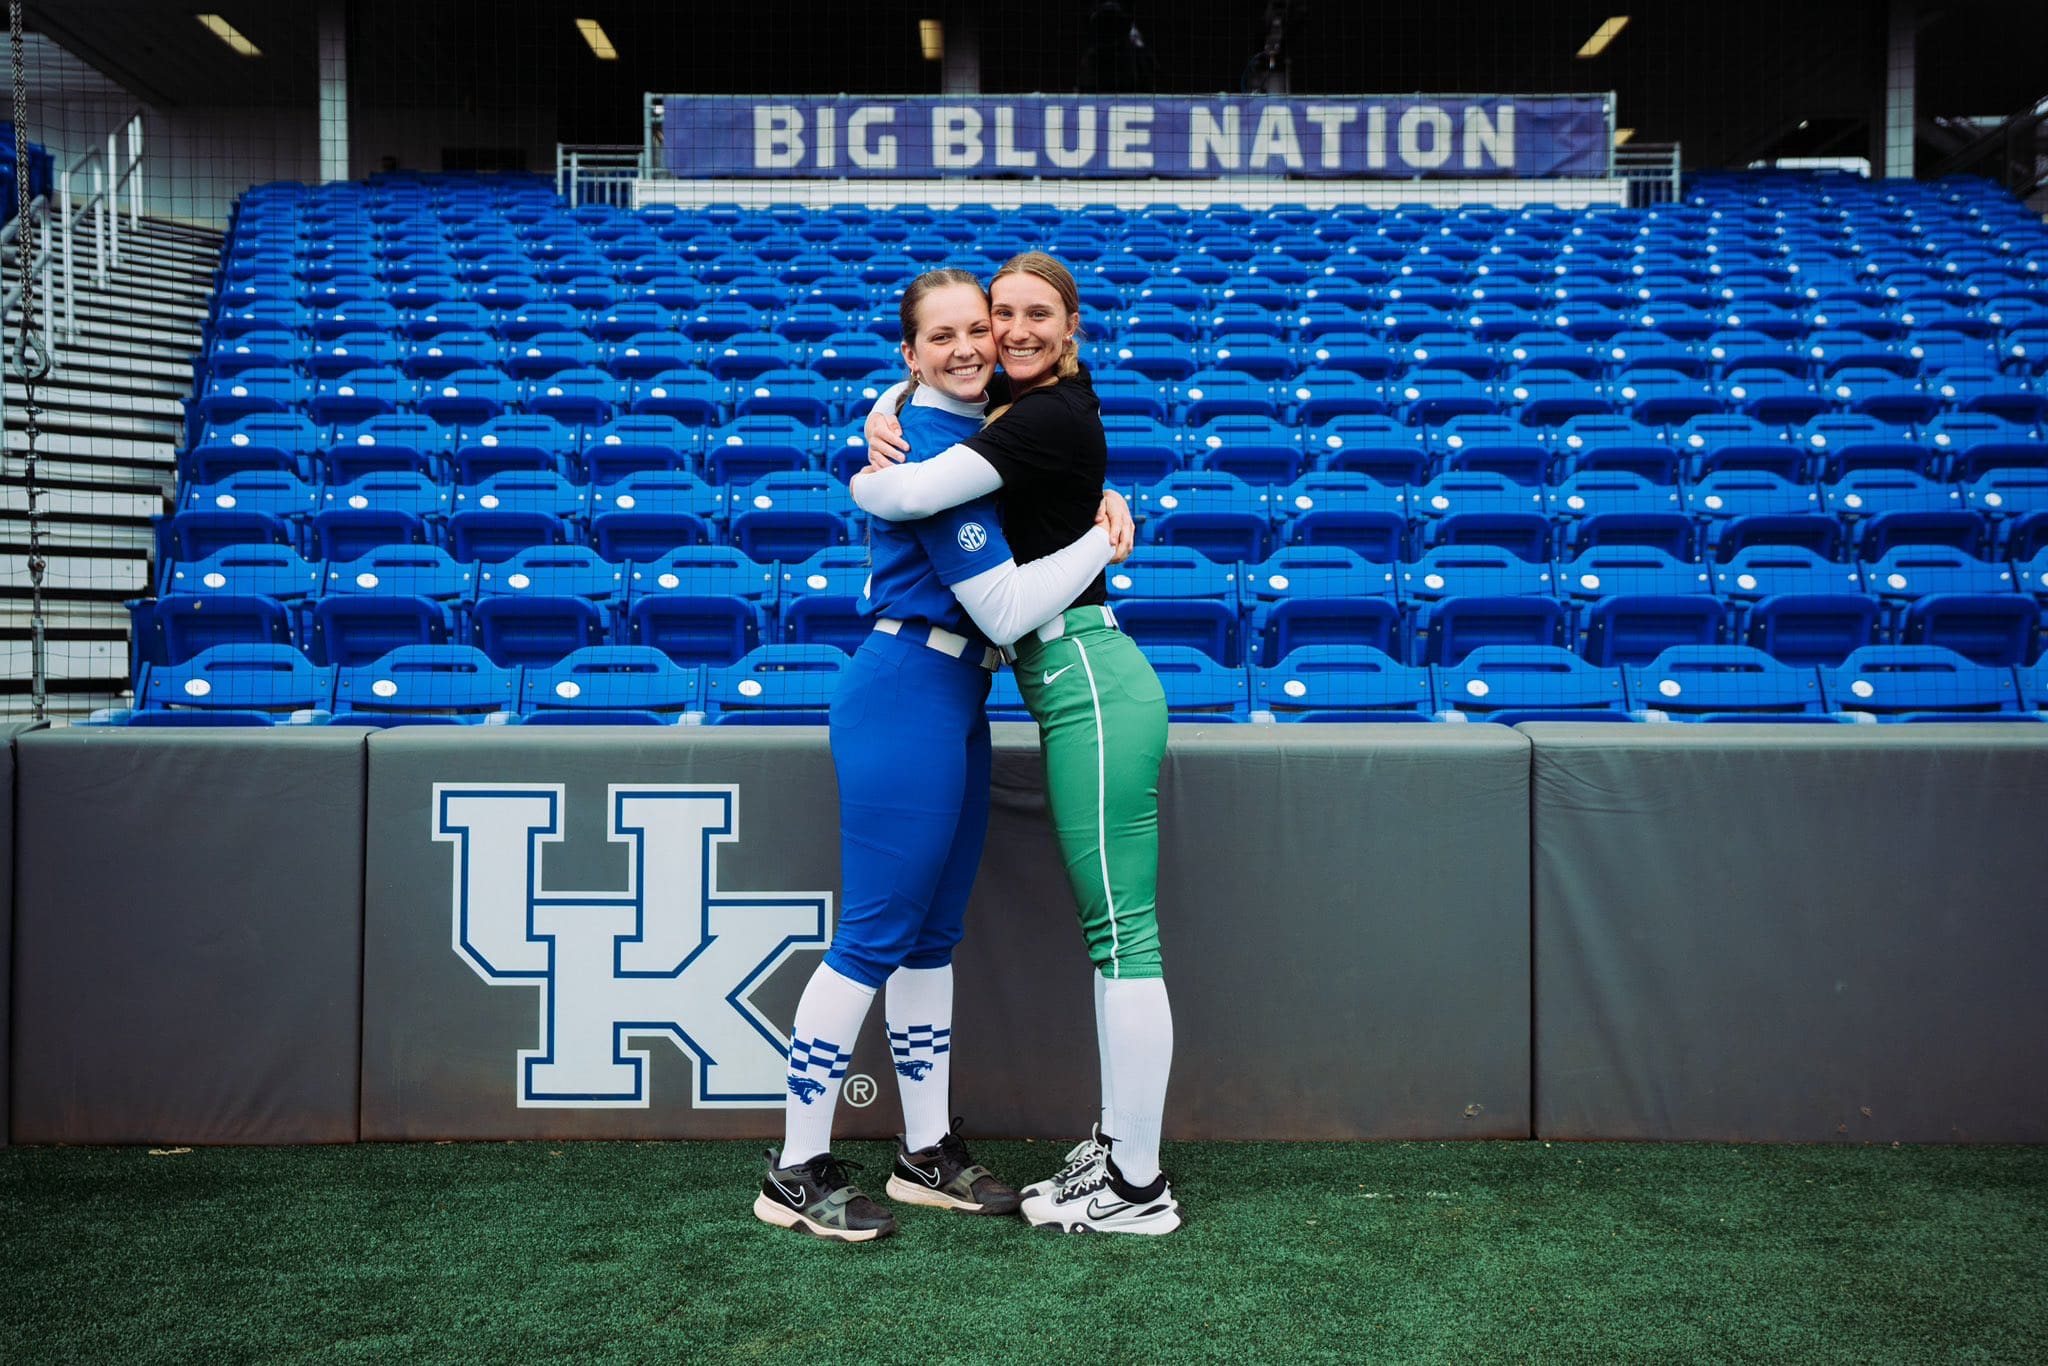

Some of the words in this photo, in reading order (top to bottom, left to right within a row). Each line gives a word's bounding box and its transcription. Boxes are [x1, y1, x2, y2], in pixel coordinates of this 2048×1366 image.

[753, 104, 898, 169] BIG
[932, 104, 1154, 170] BLUE
[1188, 104, 1516, 170] NATION
[959, 524, 985, 550] SEC
[432, 782, 833, 1109] UK
